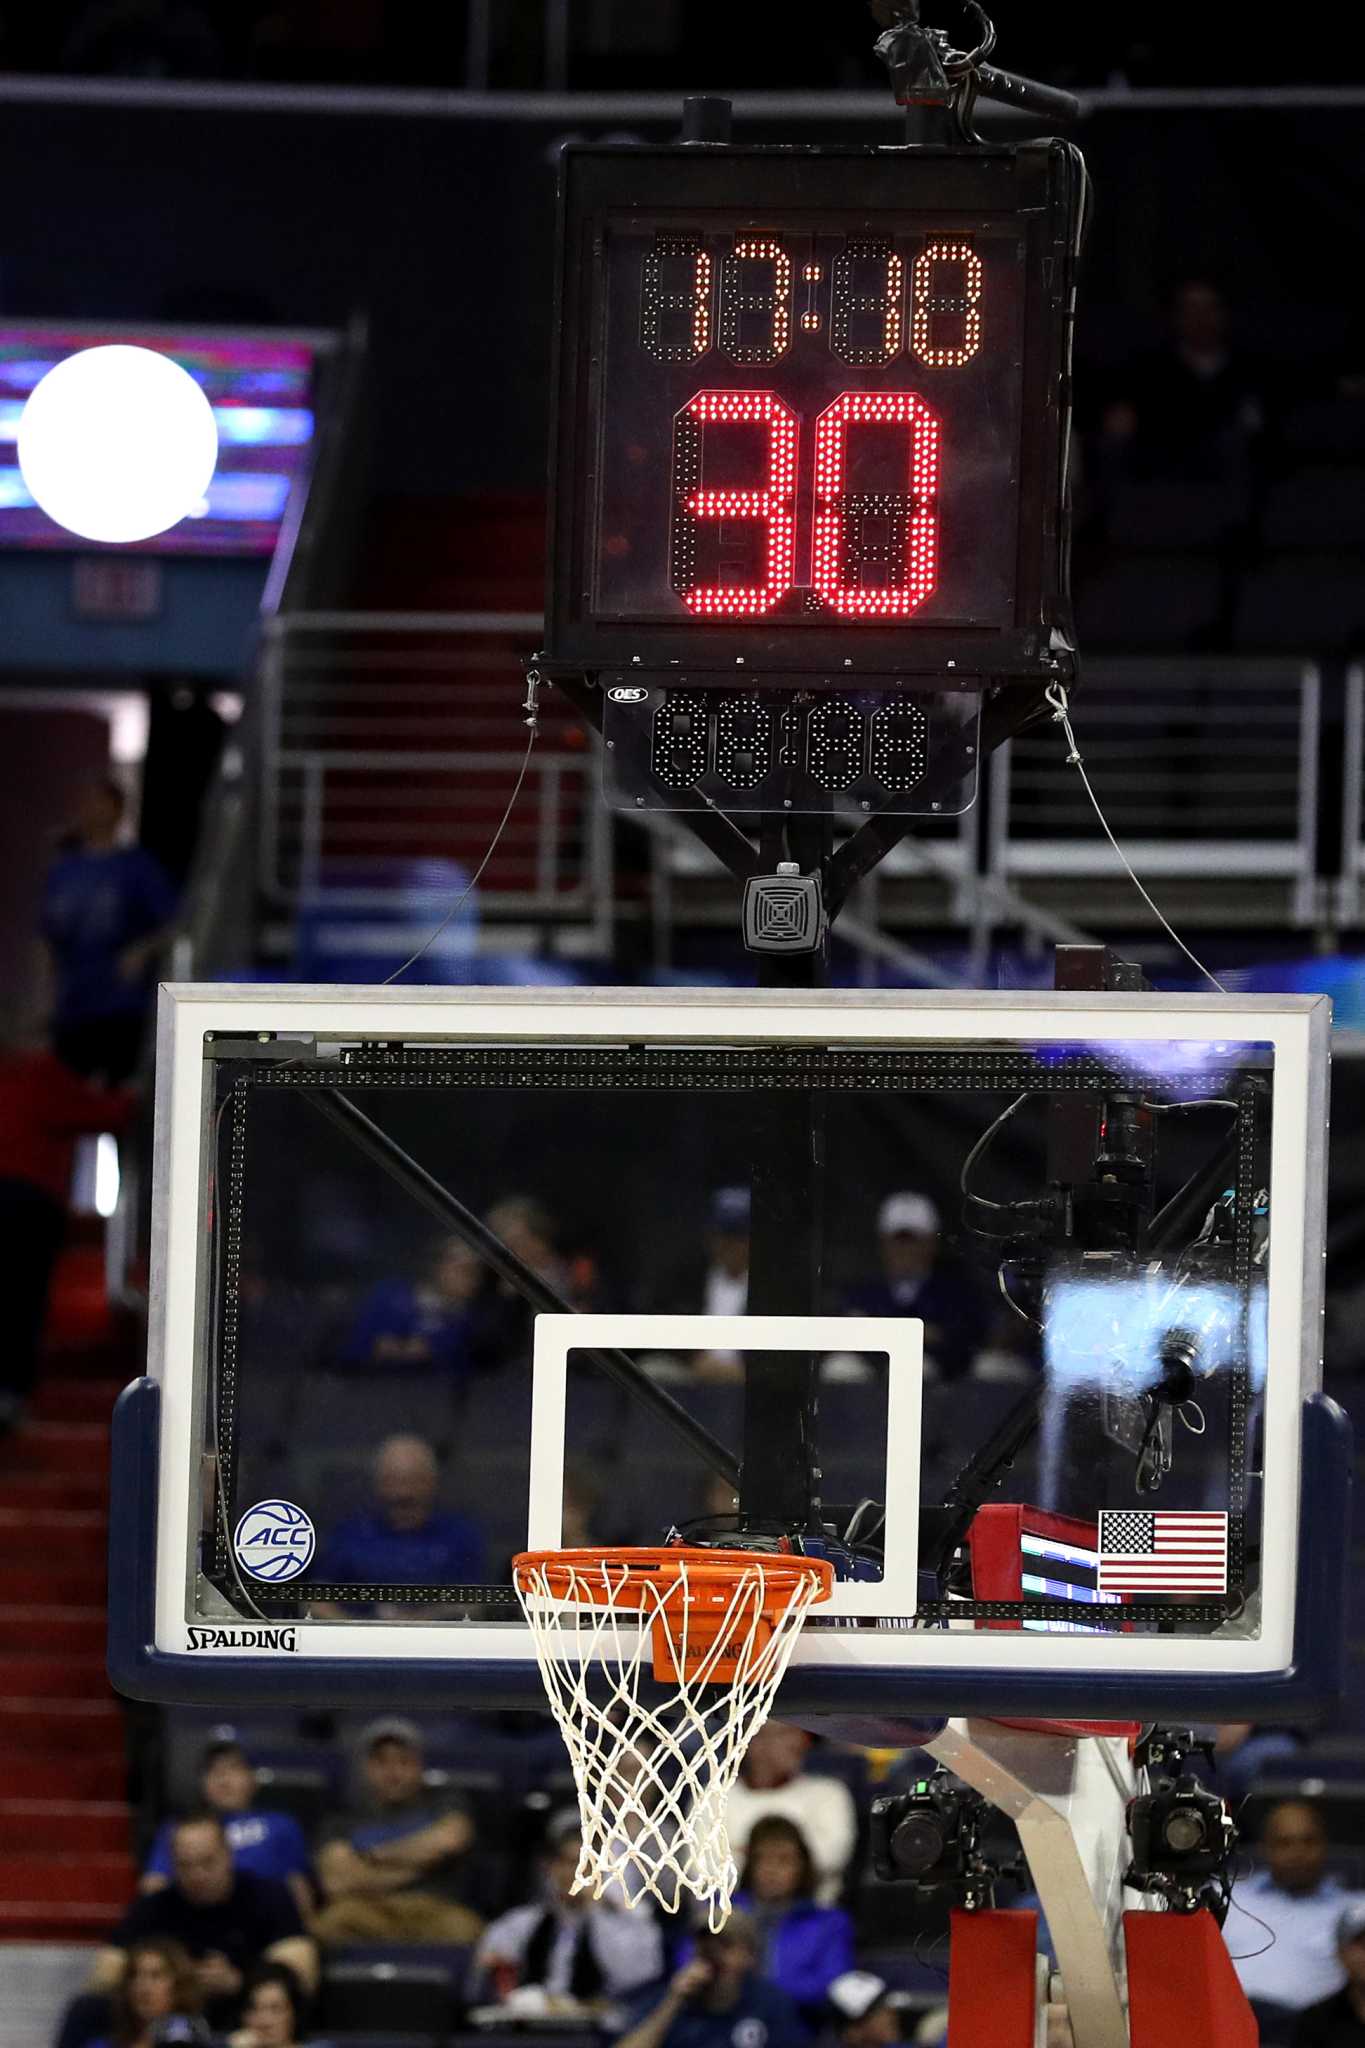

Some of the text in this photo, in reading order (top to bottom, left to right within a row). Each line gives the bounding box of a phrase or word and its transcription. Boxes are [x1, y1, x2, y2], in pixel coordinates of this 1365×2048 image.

[685, 393, 939, 615] 30
[613, 688, 641, 700] OES
[244, 1528, 311, 1546] ACC
[186, 1626, 297, 1652] SPALDING
